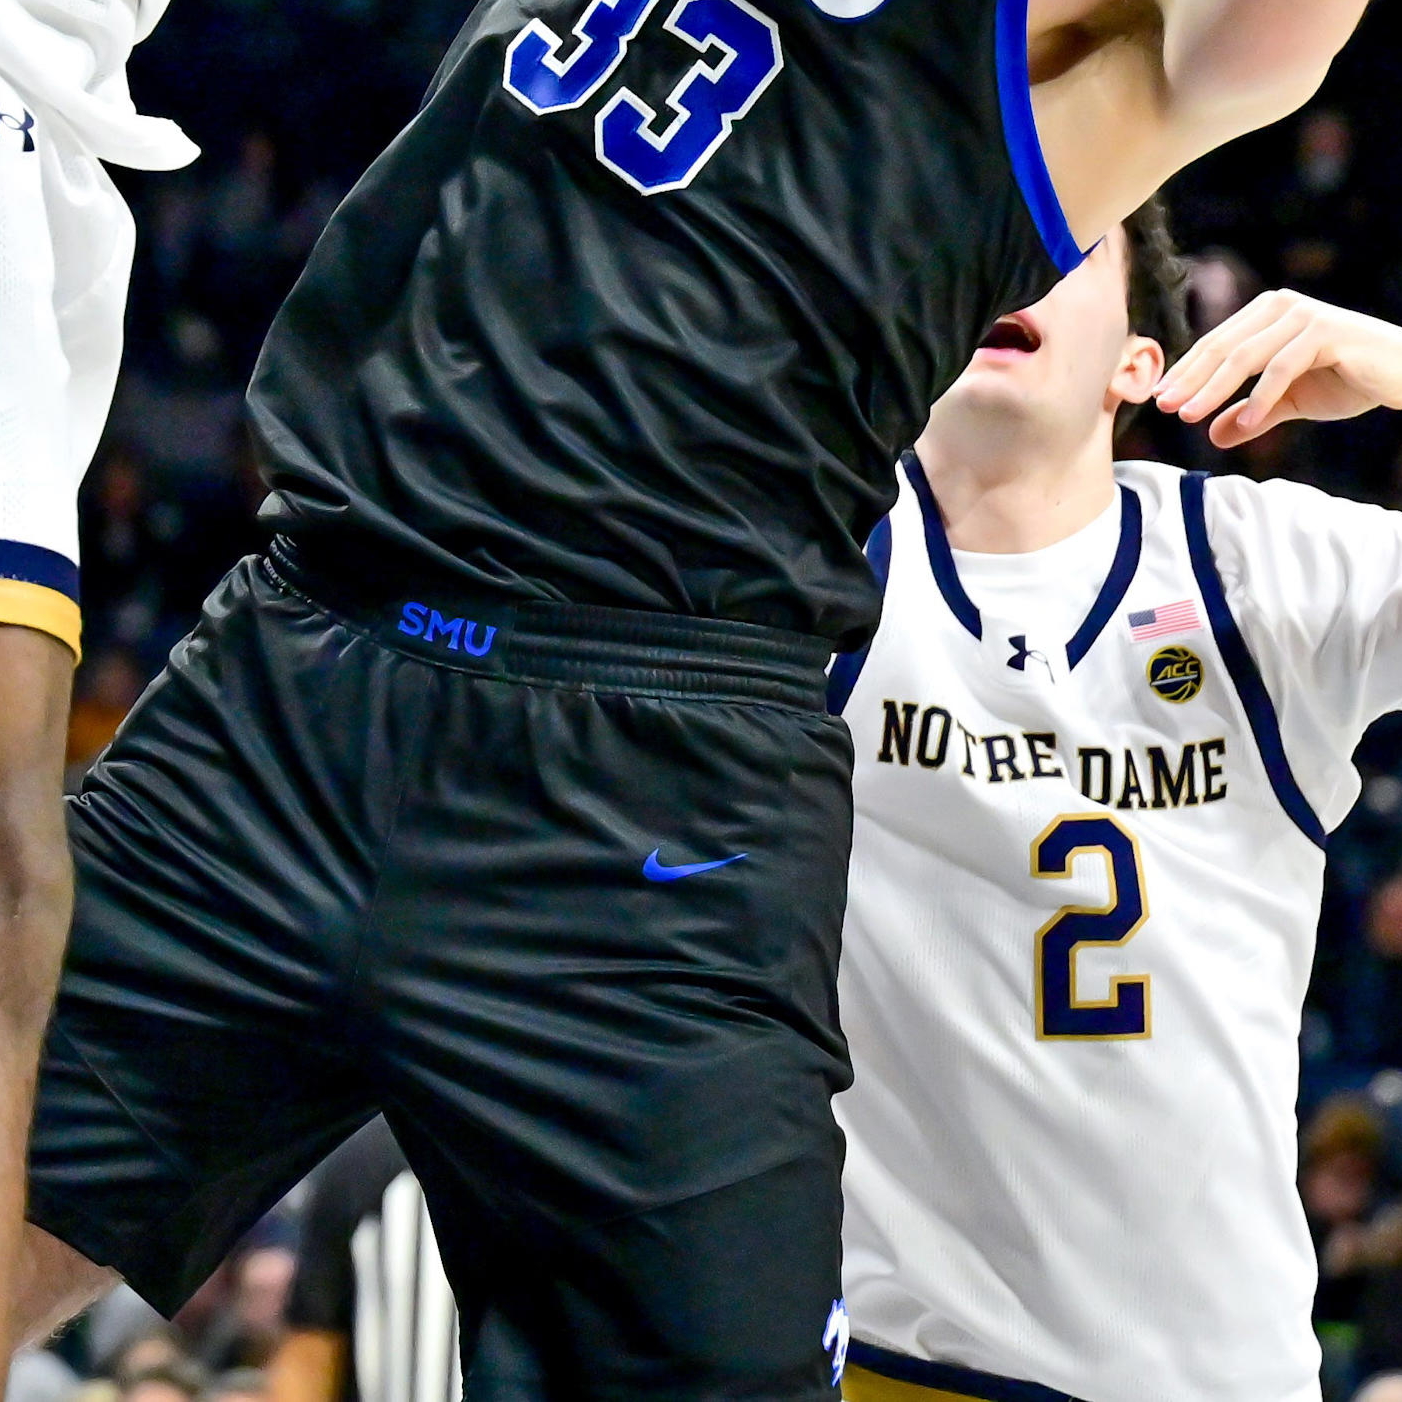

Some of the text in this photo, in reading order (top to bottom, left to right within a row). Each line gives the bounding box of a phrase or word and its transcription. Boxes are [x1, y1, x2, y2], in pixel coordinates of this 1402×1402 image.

[398, 600, 498, 658] SMU
[877, 699, 1230, 811] NOTRE DAME
[1030, 811, 1152, 1042] 2
